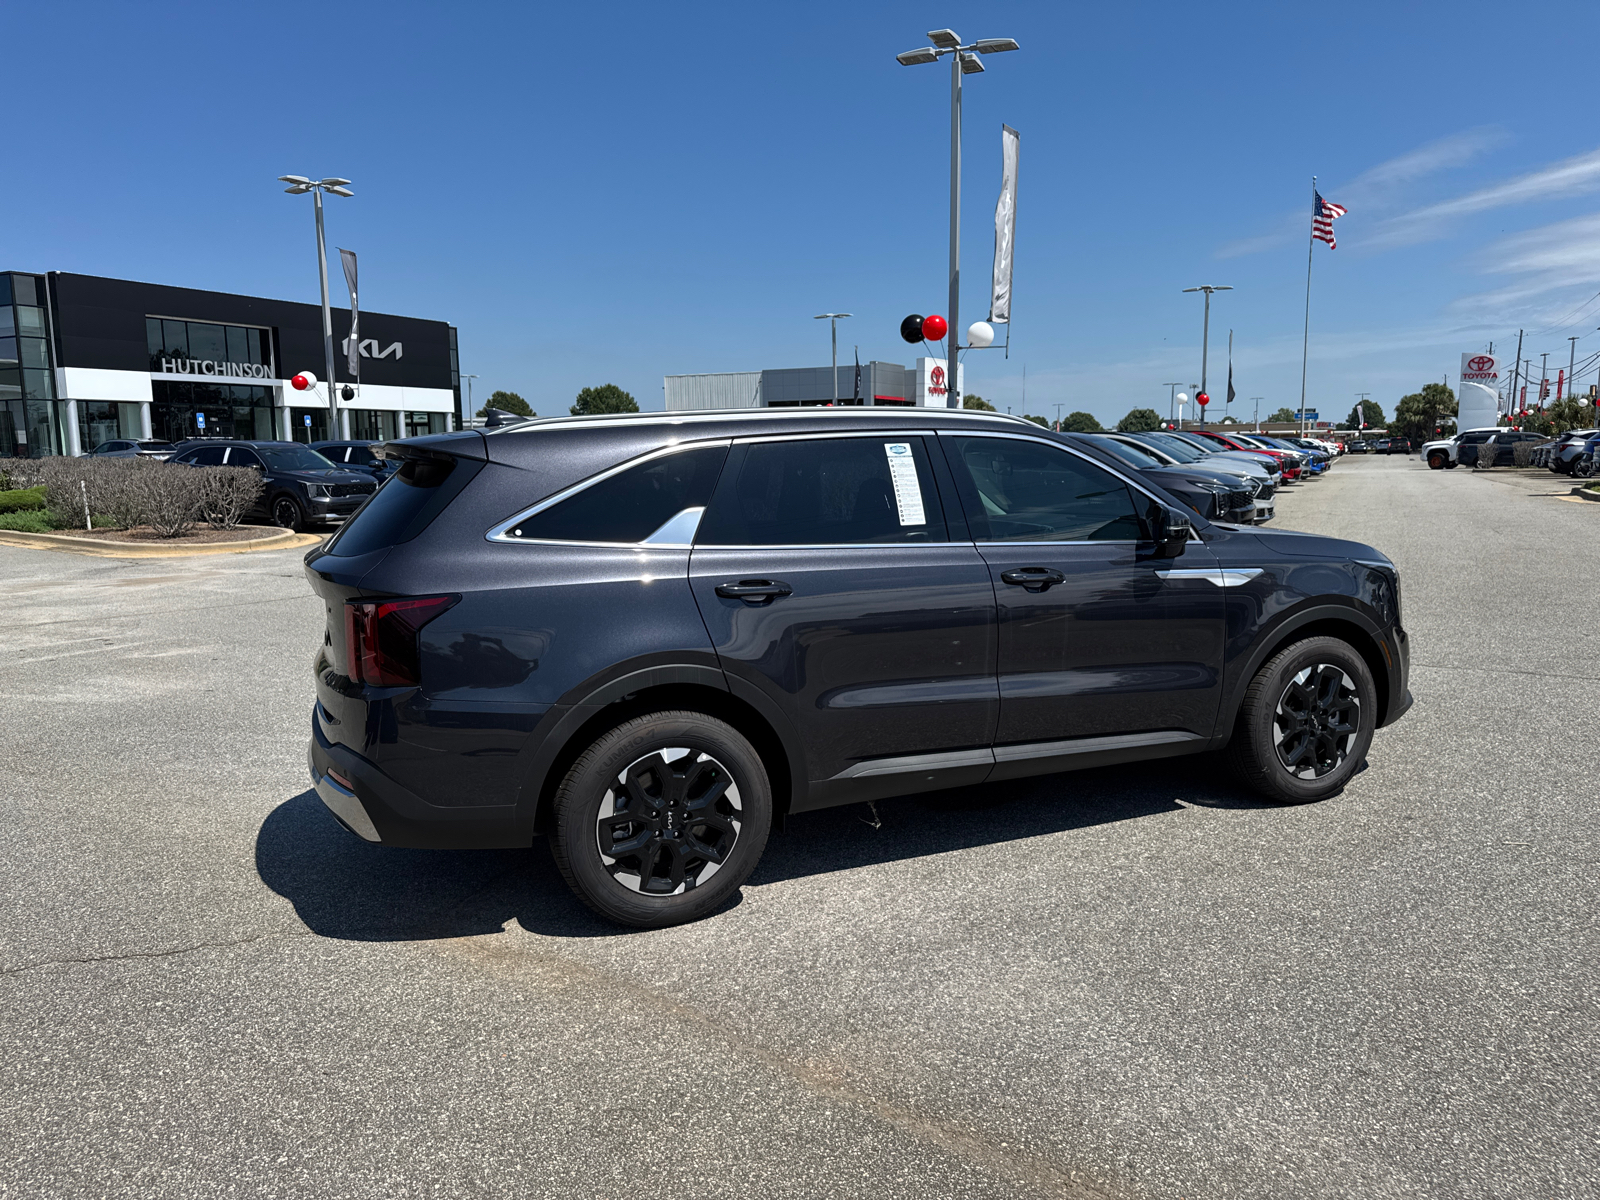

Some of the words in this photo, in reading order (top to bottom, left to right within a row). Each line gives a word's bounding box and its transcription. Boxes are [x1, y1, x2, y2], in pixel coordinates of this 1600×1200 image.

[161, 357, 275, 379] HUTCHINSON
[1462, 372, 1498, 380] TOYOTA
[595, 736, 644, 777] KUMHO
